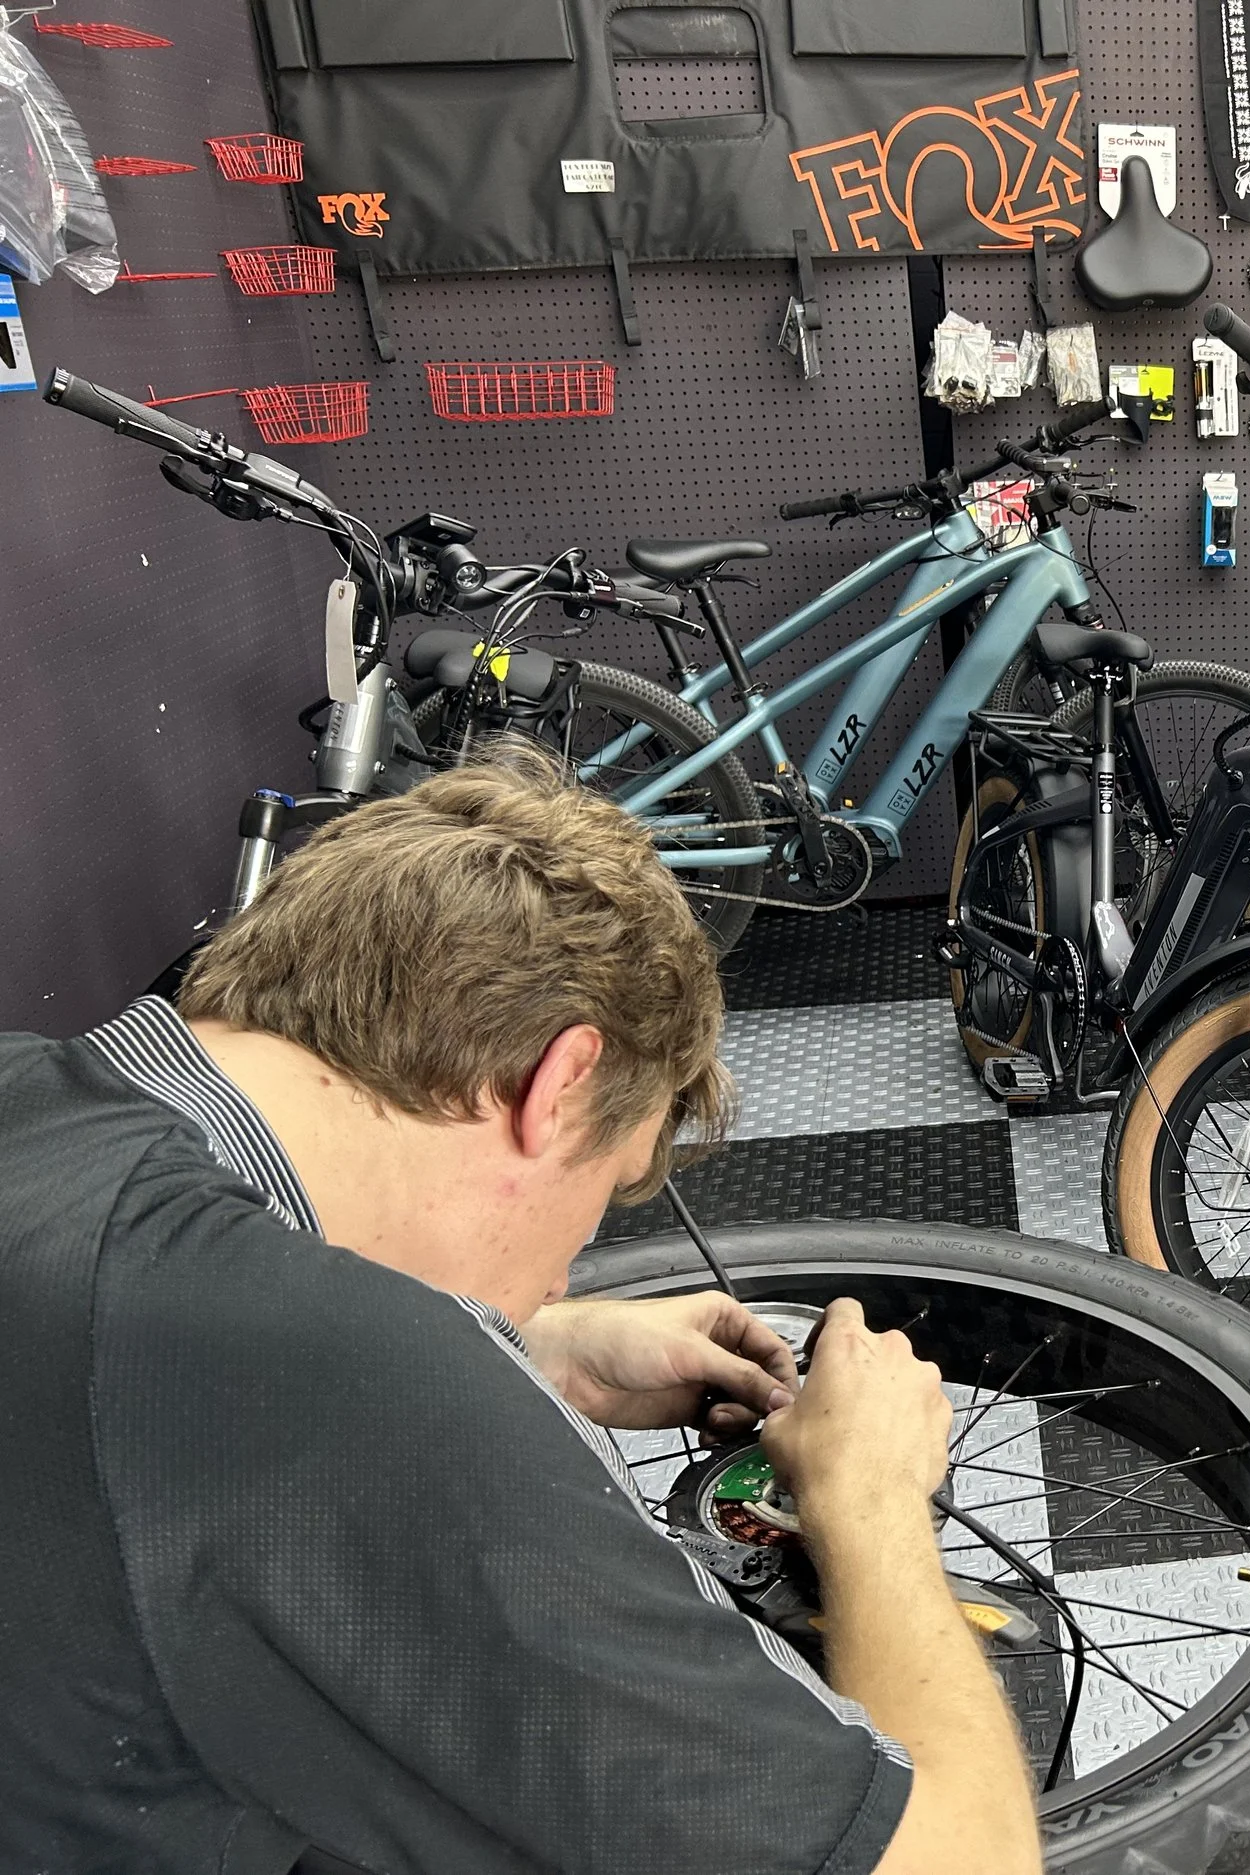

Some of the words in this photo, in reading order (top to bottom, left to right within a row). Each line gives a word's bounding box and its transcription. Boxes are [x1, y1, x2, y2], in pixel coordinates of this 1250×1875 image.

[789, 69, 1086, 250] FOX
[1108, 137, 1166, 147] SCHWINN
[317, 193, 390, 239] FOX
[829, 714, 867, 766] LZR
[903, 743, 945, 797] LZR
[1143, 921, 1178, 998] AVENTON
[890, 1236, 925, 1248] MAX
[934, 1240, 994, 1256] INFLATE
[1003, 1250, 1023, 1260] TO
[1030, 1255, 1048, 1266] 20
[1100, 1274, 1124, 1288] 140
